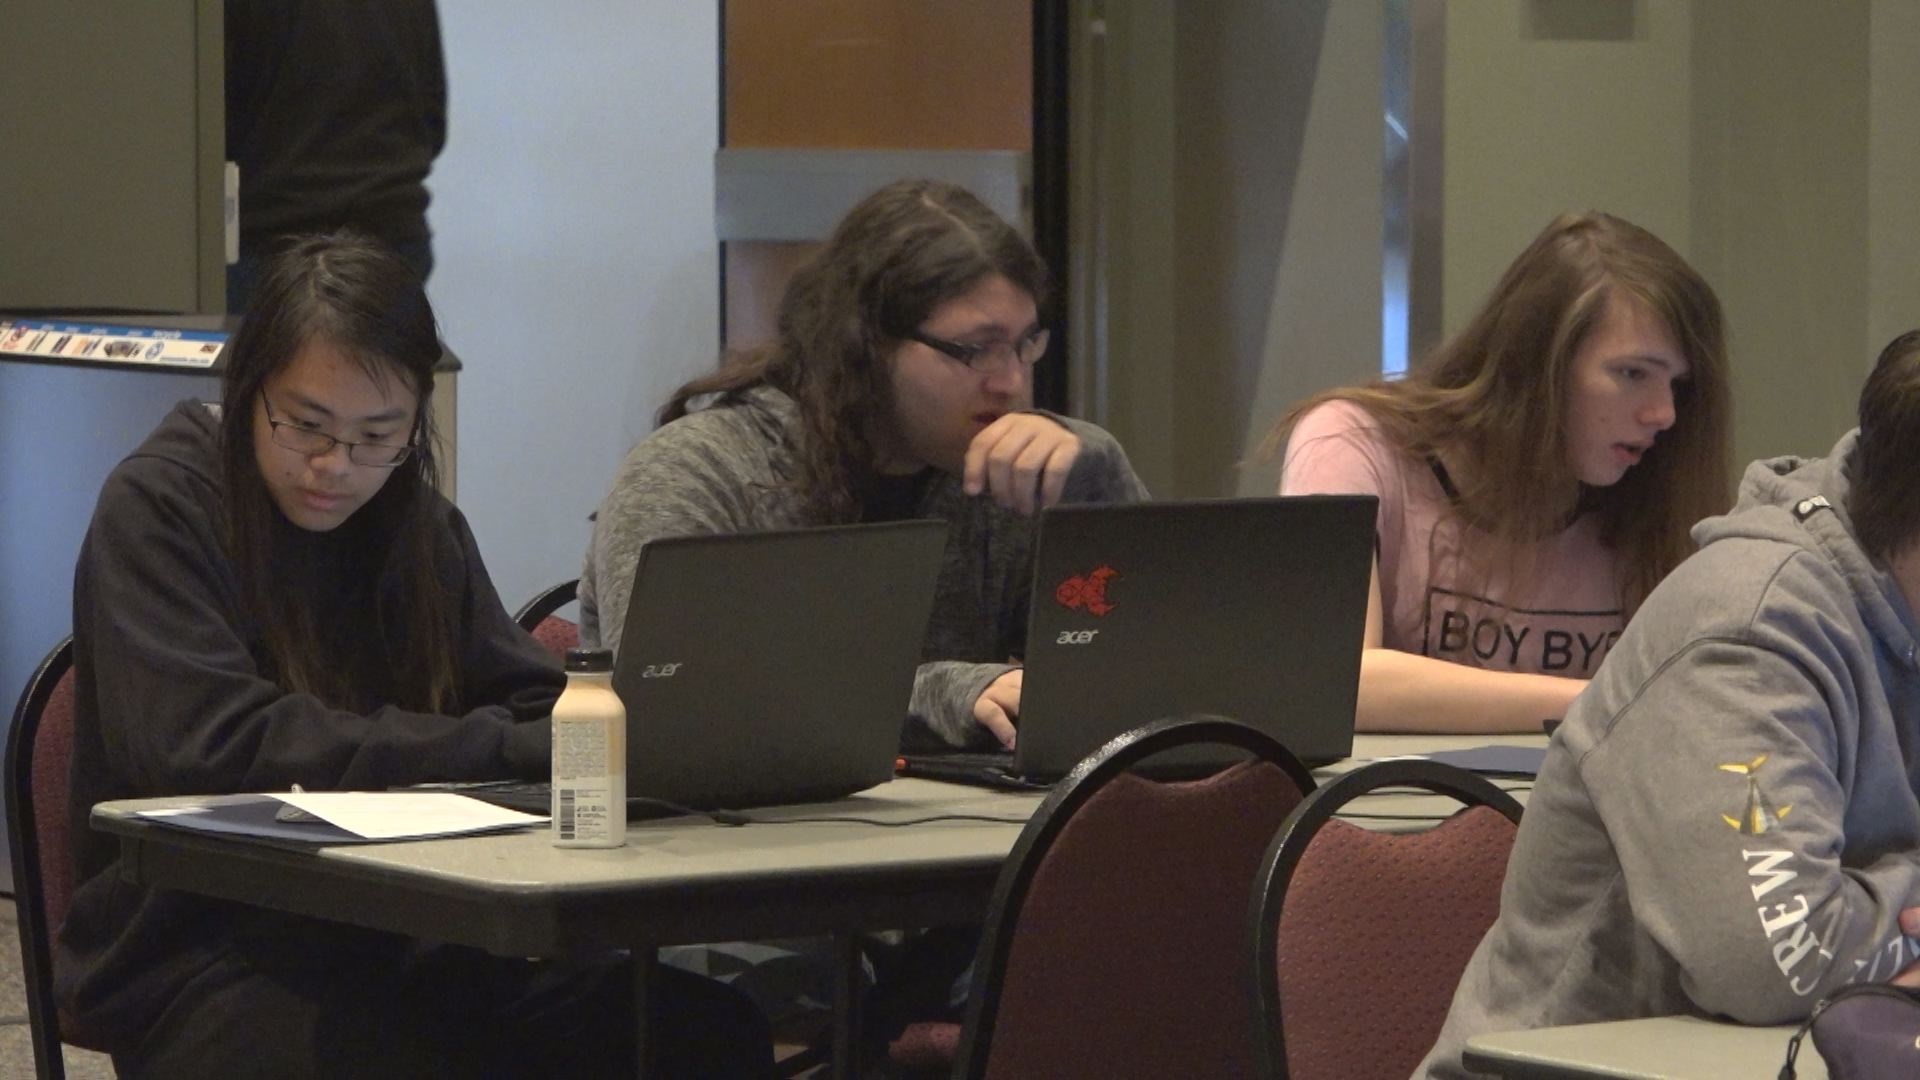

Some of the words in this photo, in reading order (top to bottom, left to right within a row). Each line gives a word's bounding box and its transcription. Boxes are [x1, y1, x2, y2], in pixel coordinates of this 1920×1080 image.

[1056, 629, 1099, 645] acer
[1438, 611, 1530, 665] BOY
[642, 662, 683, 679] acer
[1742, 849, 1833, 997] CREW
